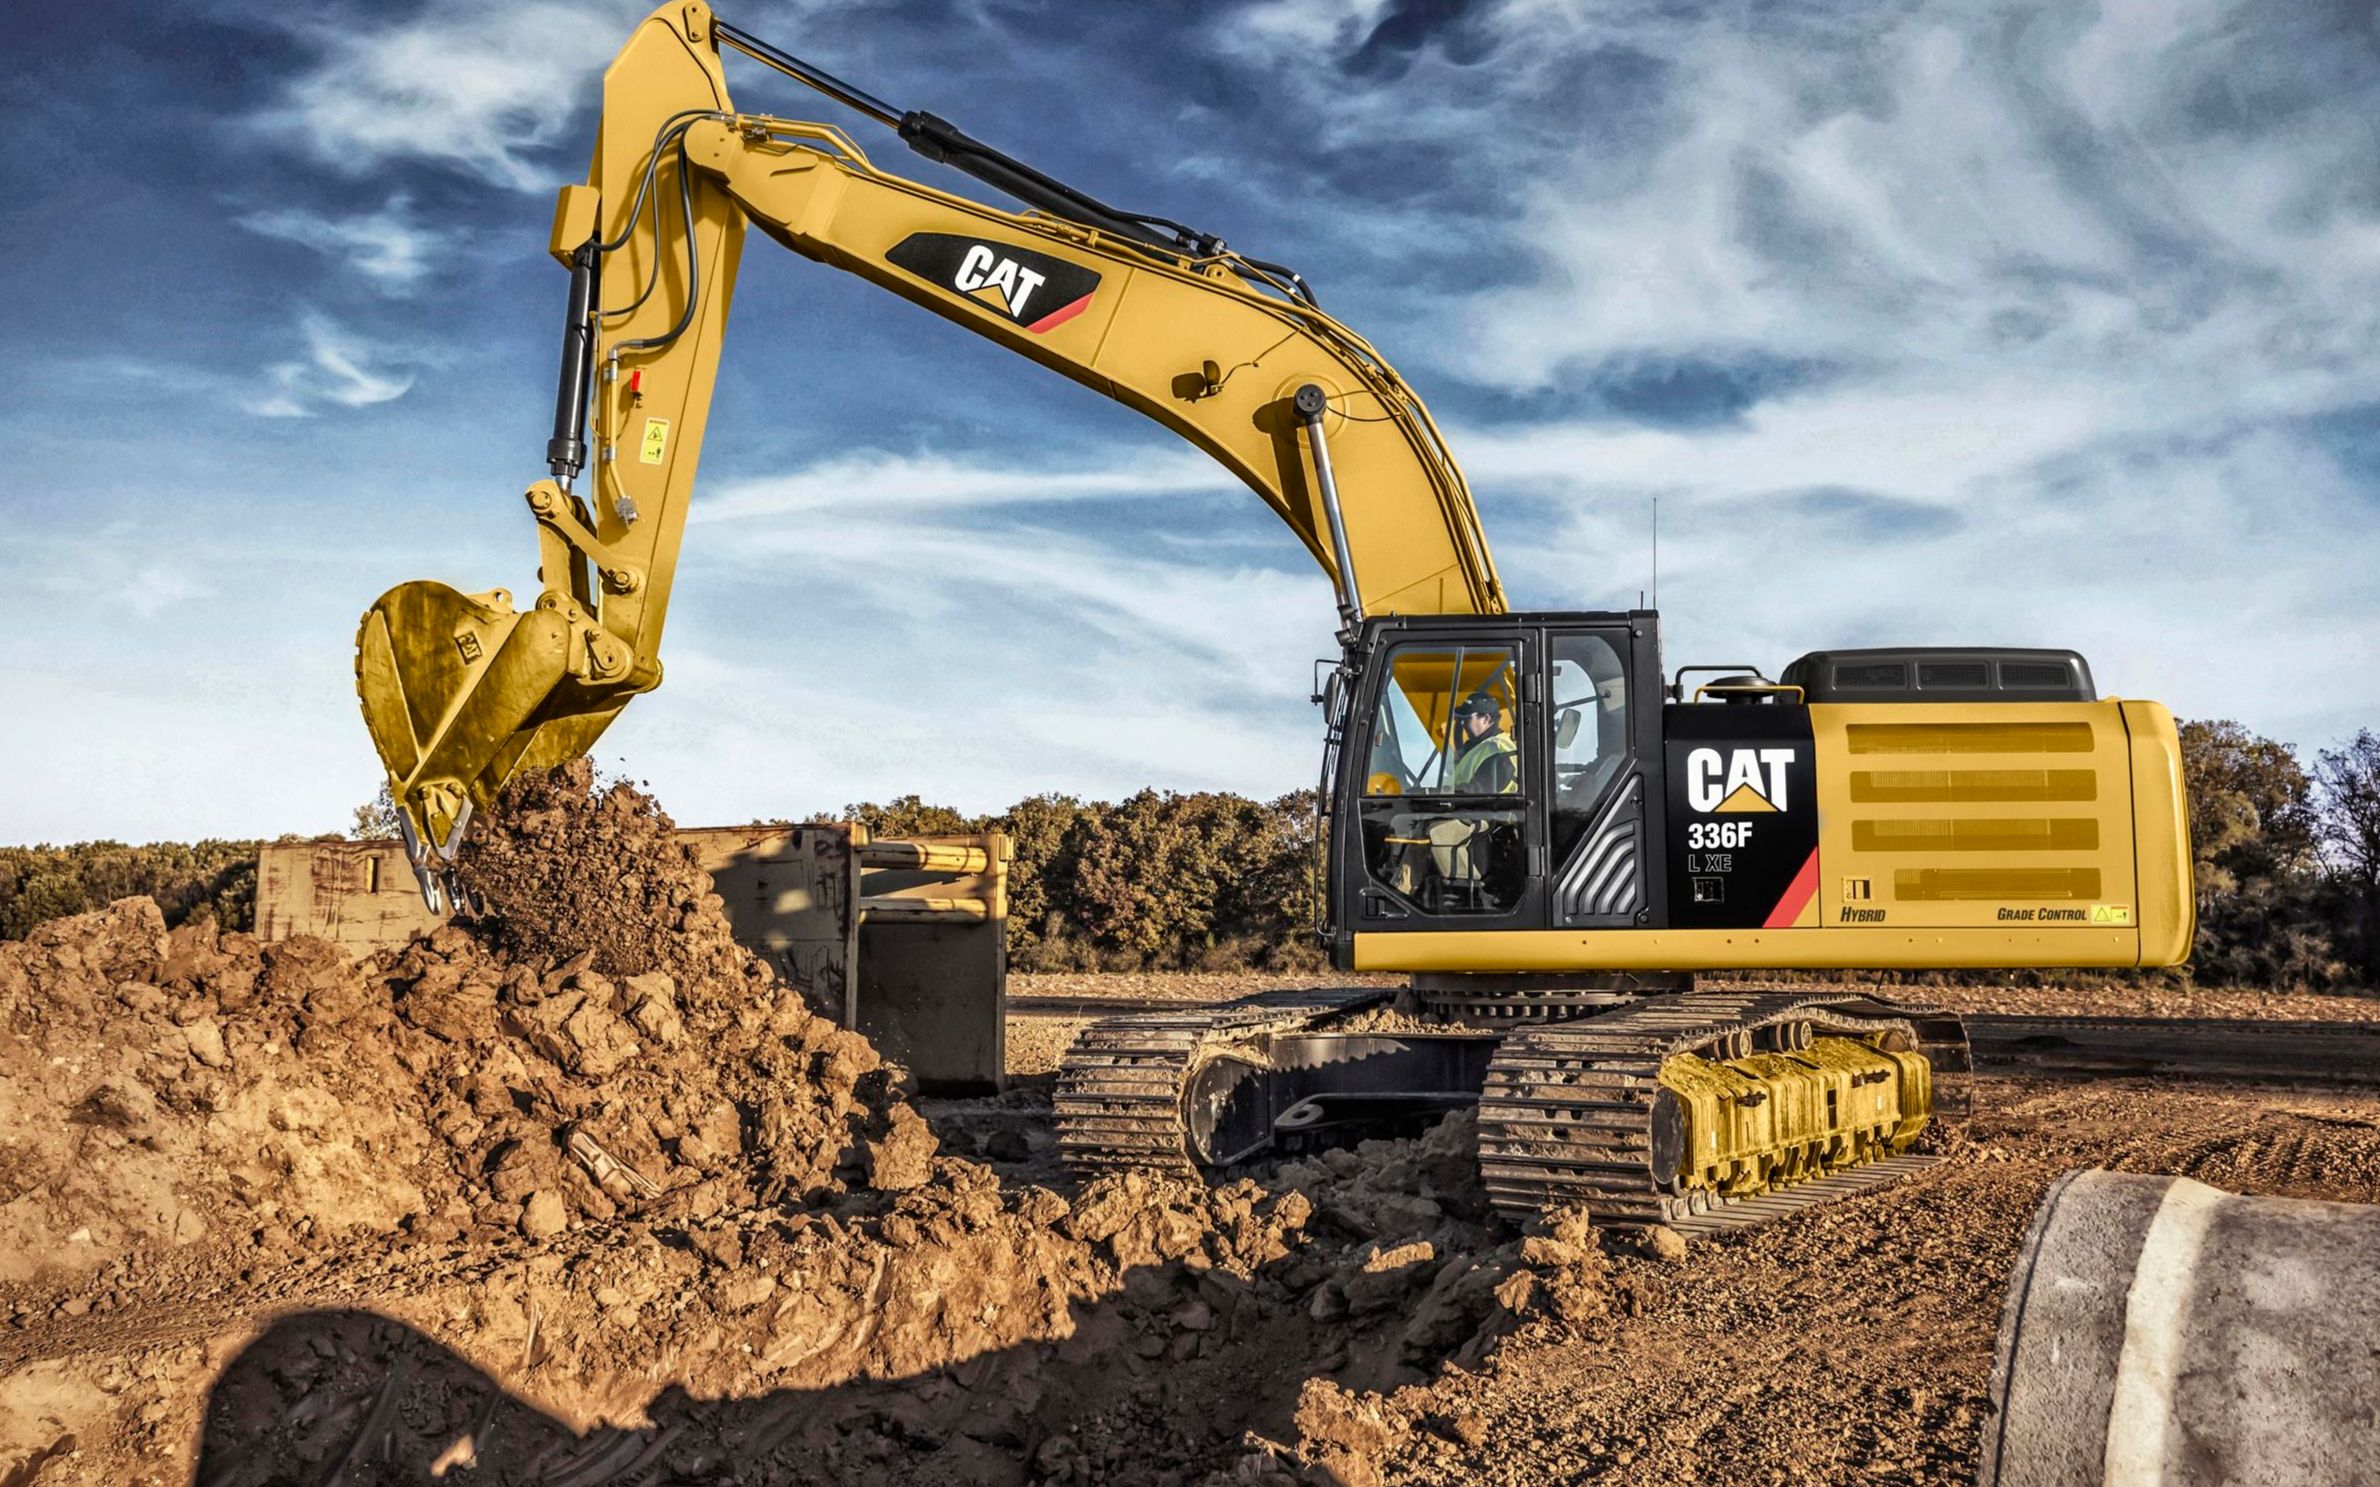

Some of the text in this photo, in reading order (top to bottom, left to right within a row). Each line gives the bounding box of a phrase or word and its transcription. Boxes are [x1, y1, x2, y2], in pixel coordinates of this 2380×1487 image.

[954, 244, 1046, 318] CAT
[1687, 747, 1795, 813] CAT
[1688, 821, 1753, 849] 336F
[1688, 854, 1732, 872] L XE
